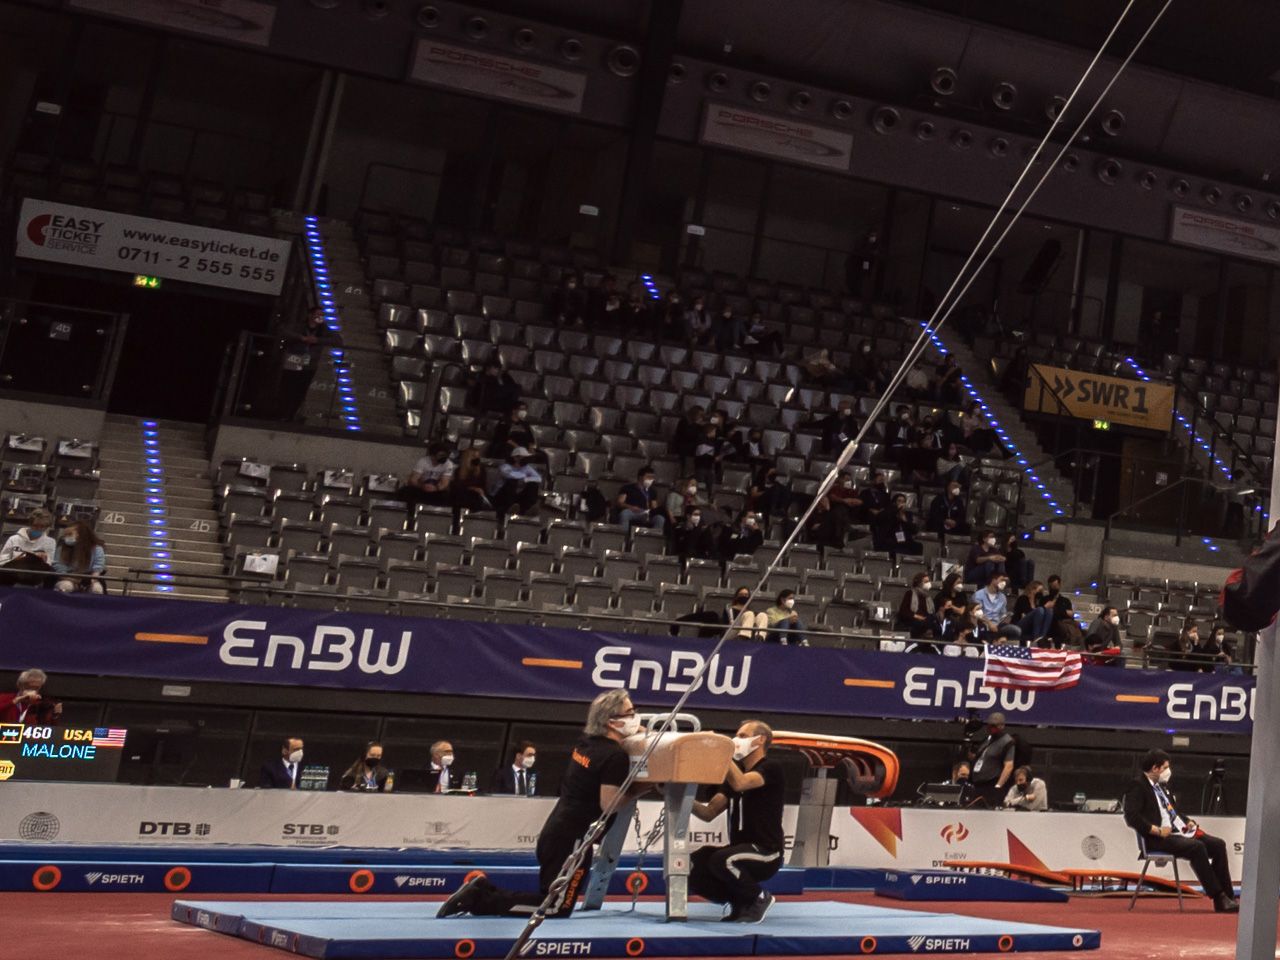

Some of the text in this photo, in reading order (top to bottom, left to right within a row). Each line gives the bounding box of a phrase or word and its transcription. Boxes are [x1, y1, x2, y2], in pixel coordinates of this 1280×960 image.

[51, 214, 105, 234] EASY
[50, 227, 102, 244] TICKET
[46, 240, 97, 256] SERVICE
[123, 228, 281, 262] www.easyticket.de
[118, 246, 160, 265] 0711
[178, 256, 190, 269] 2
[197, 259, 233, 276] 555
[240, 265, 275, 282] 555
[103, 512, 126, 525] 4b
[189, 519, 210, 533] 4b
[218, 619, 412, 676] EnBW
[591, 645, 752, 697] EnBW
[1165, 683, 1256, 722] EnB
[23, 726, 94, 741] 460 USA
[22, 743, 97, 760] MALONE
[139, 821, 192, 836] DTB
[283, 823, 325, 835] STB
[688, 832, 722, 843] IETH
[101, 873, 144, 885] SPIETH
[408, 877, 446, 887] SPIETH
[925, 875, 967, 885] SPIETH
[536, 941, 591, 956] SPIETH
[925, 939, 970, 951] SPIETH
